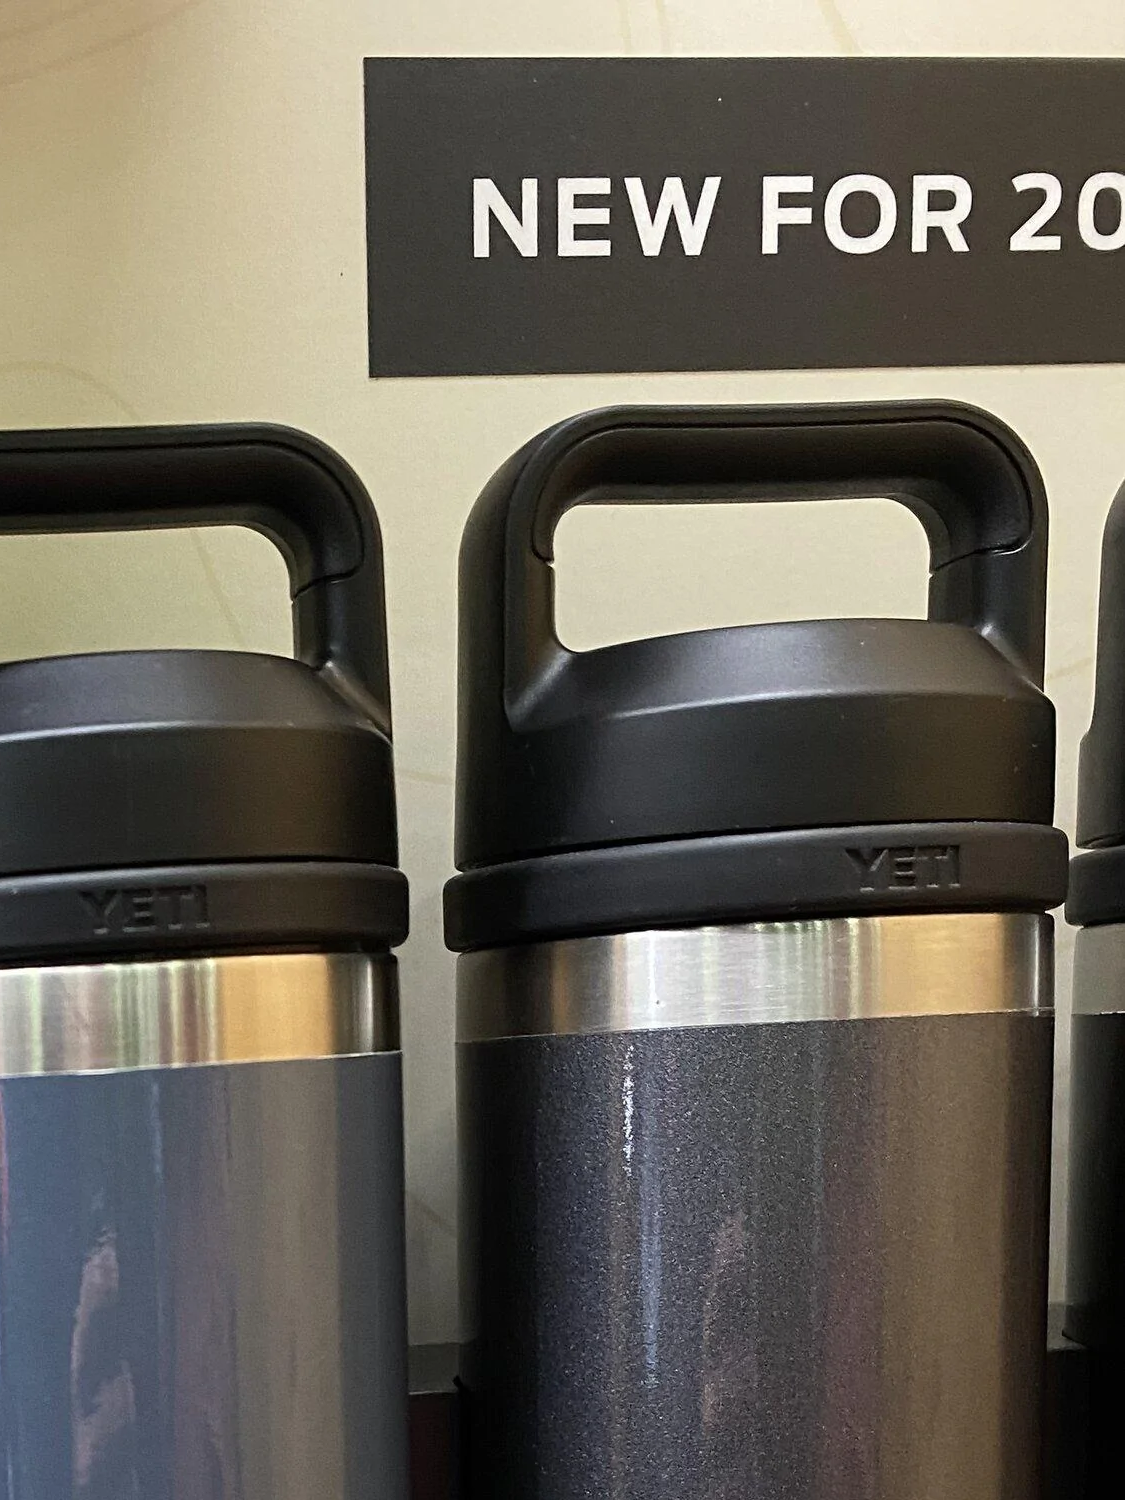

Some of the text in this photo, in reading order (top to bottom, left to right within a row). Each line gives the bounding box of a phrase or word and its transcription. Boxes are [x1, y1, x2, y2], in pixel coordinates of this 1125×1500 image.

[472, 172, 1125, 257] NEW FOR 20
[845, 845, 961, 892] YETI
[78, 884, 210, 934] YETI
